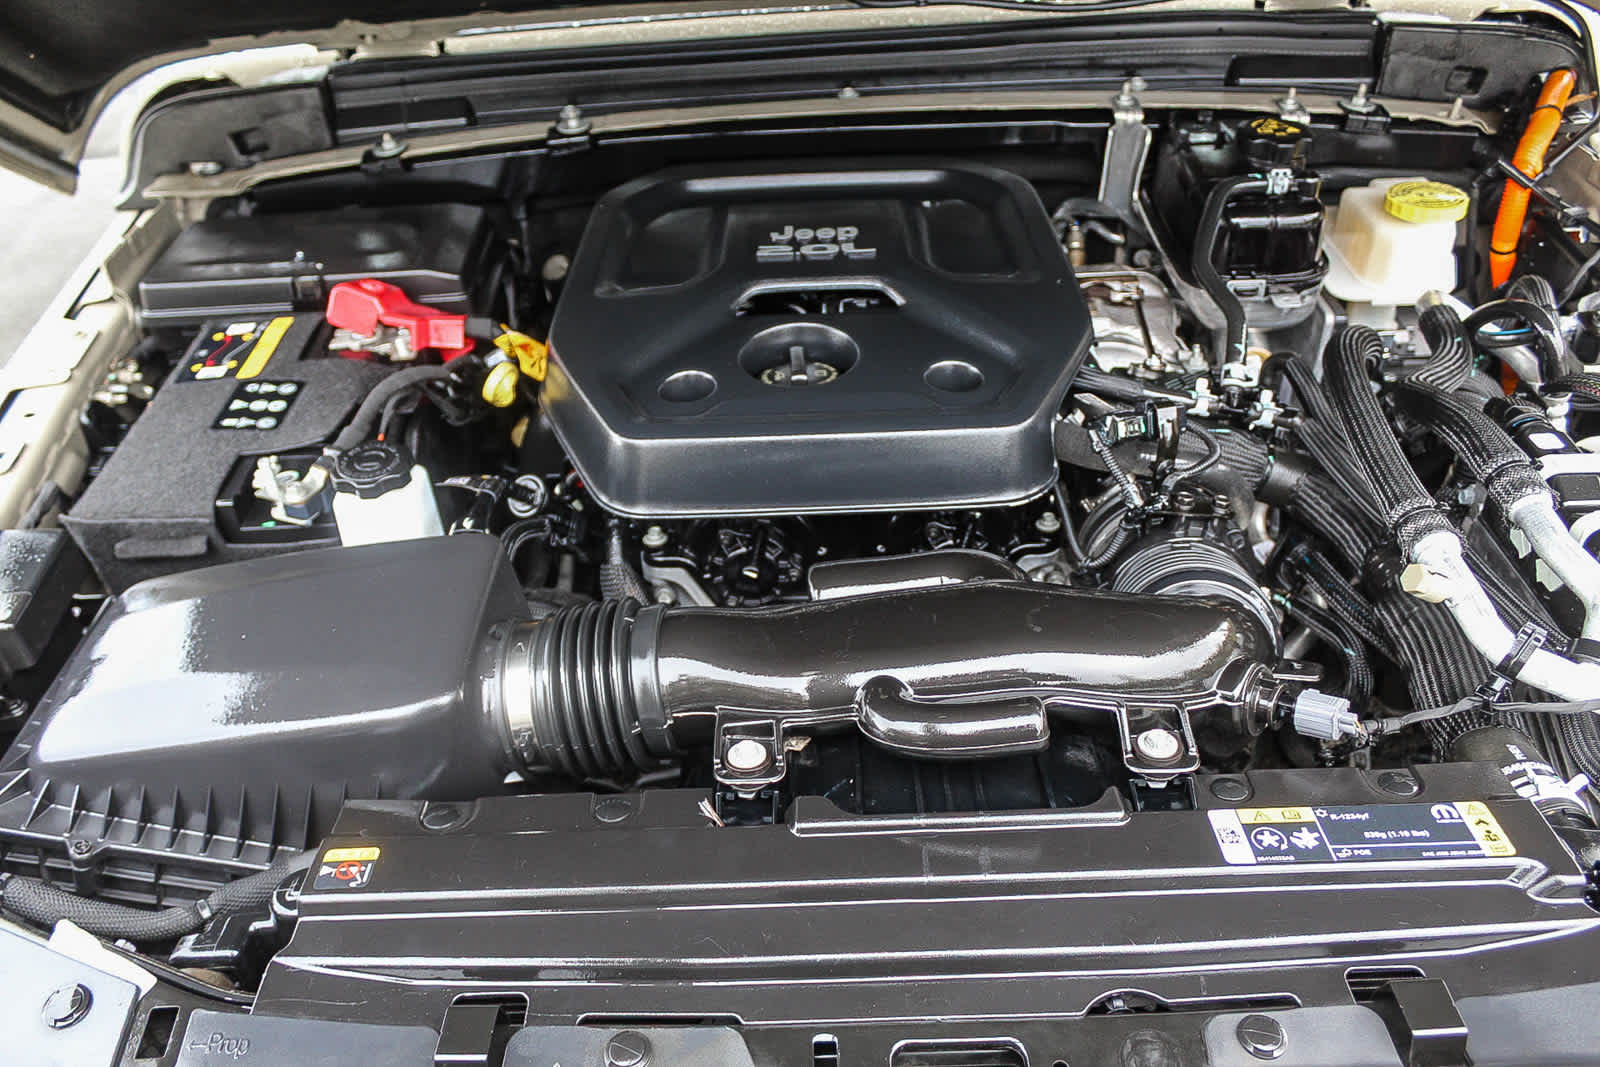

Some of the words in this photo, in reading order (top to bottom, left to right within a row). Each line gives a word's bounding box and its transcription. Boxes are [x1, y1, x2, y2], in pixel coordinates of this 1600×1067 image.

[769, 225, 859, 243] Jeep
[756, 242, 877, 262] 2.0L
[205, 1031, 250, 1060] Prop
